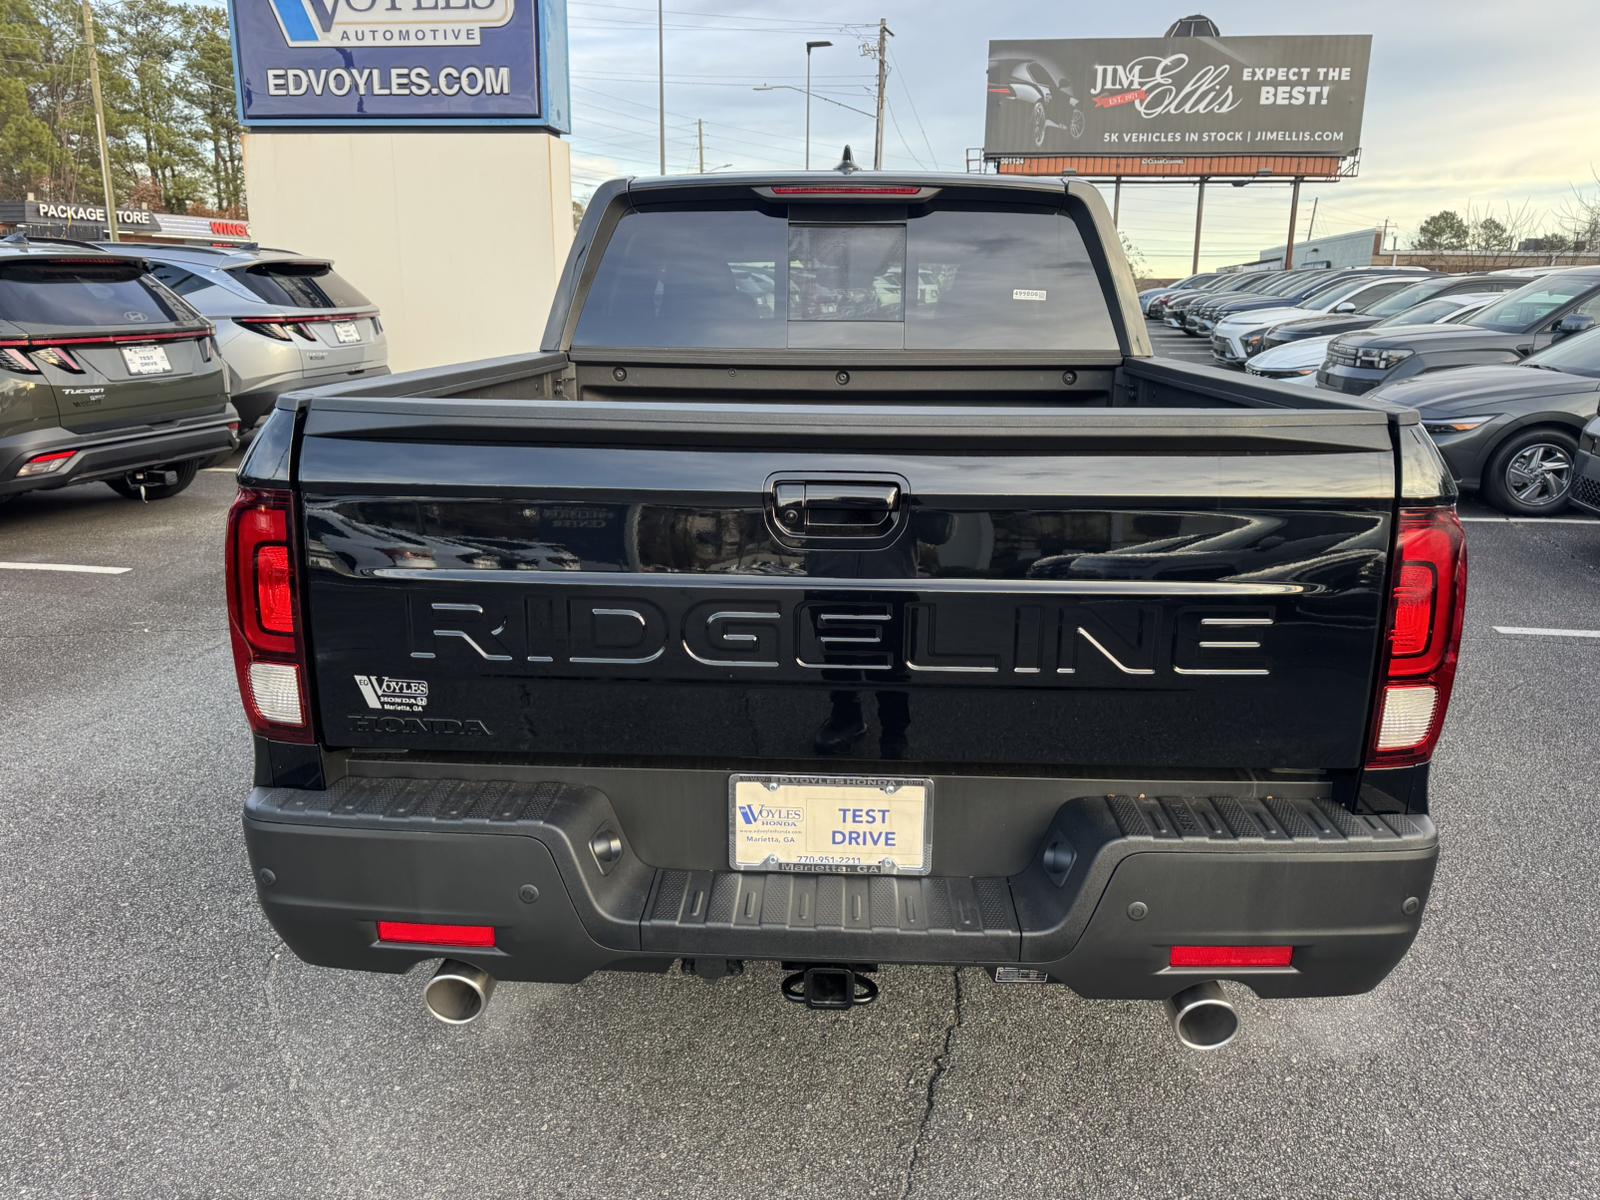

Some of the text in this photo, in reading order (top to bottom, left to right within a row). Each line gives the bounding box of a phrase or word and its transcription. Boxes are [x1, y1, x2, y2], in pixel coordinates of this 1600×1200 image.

[340, 28, 476, 42] AUTOMOTIVE
[266, 67, 510, 96] EDVOYLES.COM
[1242, 67, 1351, 81] EXPECT THE
[1090, 53, 1243, 119] JIM Ellis
[1259, 86, 1330, 105] BEST!
[1103, 131, 1344, 142] 5K VEHICLES IN STOCK JIMELLIS.COM
[39, 203, 150, 224] PACKAGE TORE
[407, 597, 1276, 675] RIDGELINE
[369, 675, 426, 696] VOYLES
[380, 696, 417, 704] HONDA
[383, 704, 412, 712] Marietta,
[347, 714, 493, 736] HONDA
[746, 804, 801, 823] VOYLES
[838, 808, 890, 824] TEST
[831, 830, 896, 847] DRIVE
[781, 863, 879, 873] Marietta, GA
[797, 855, 861, 864] 770-951-2211
